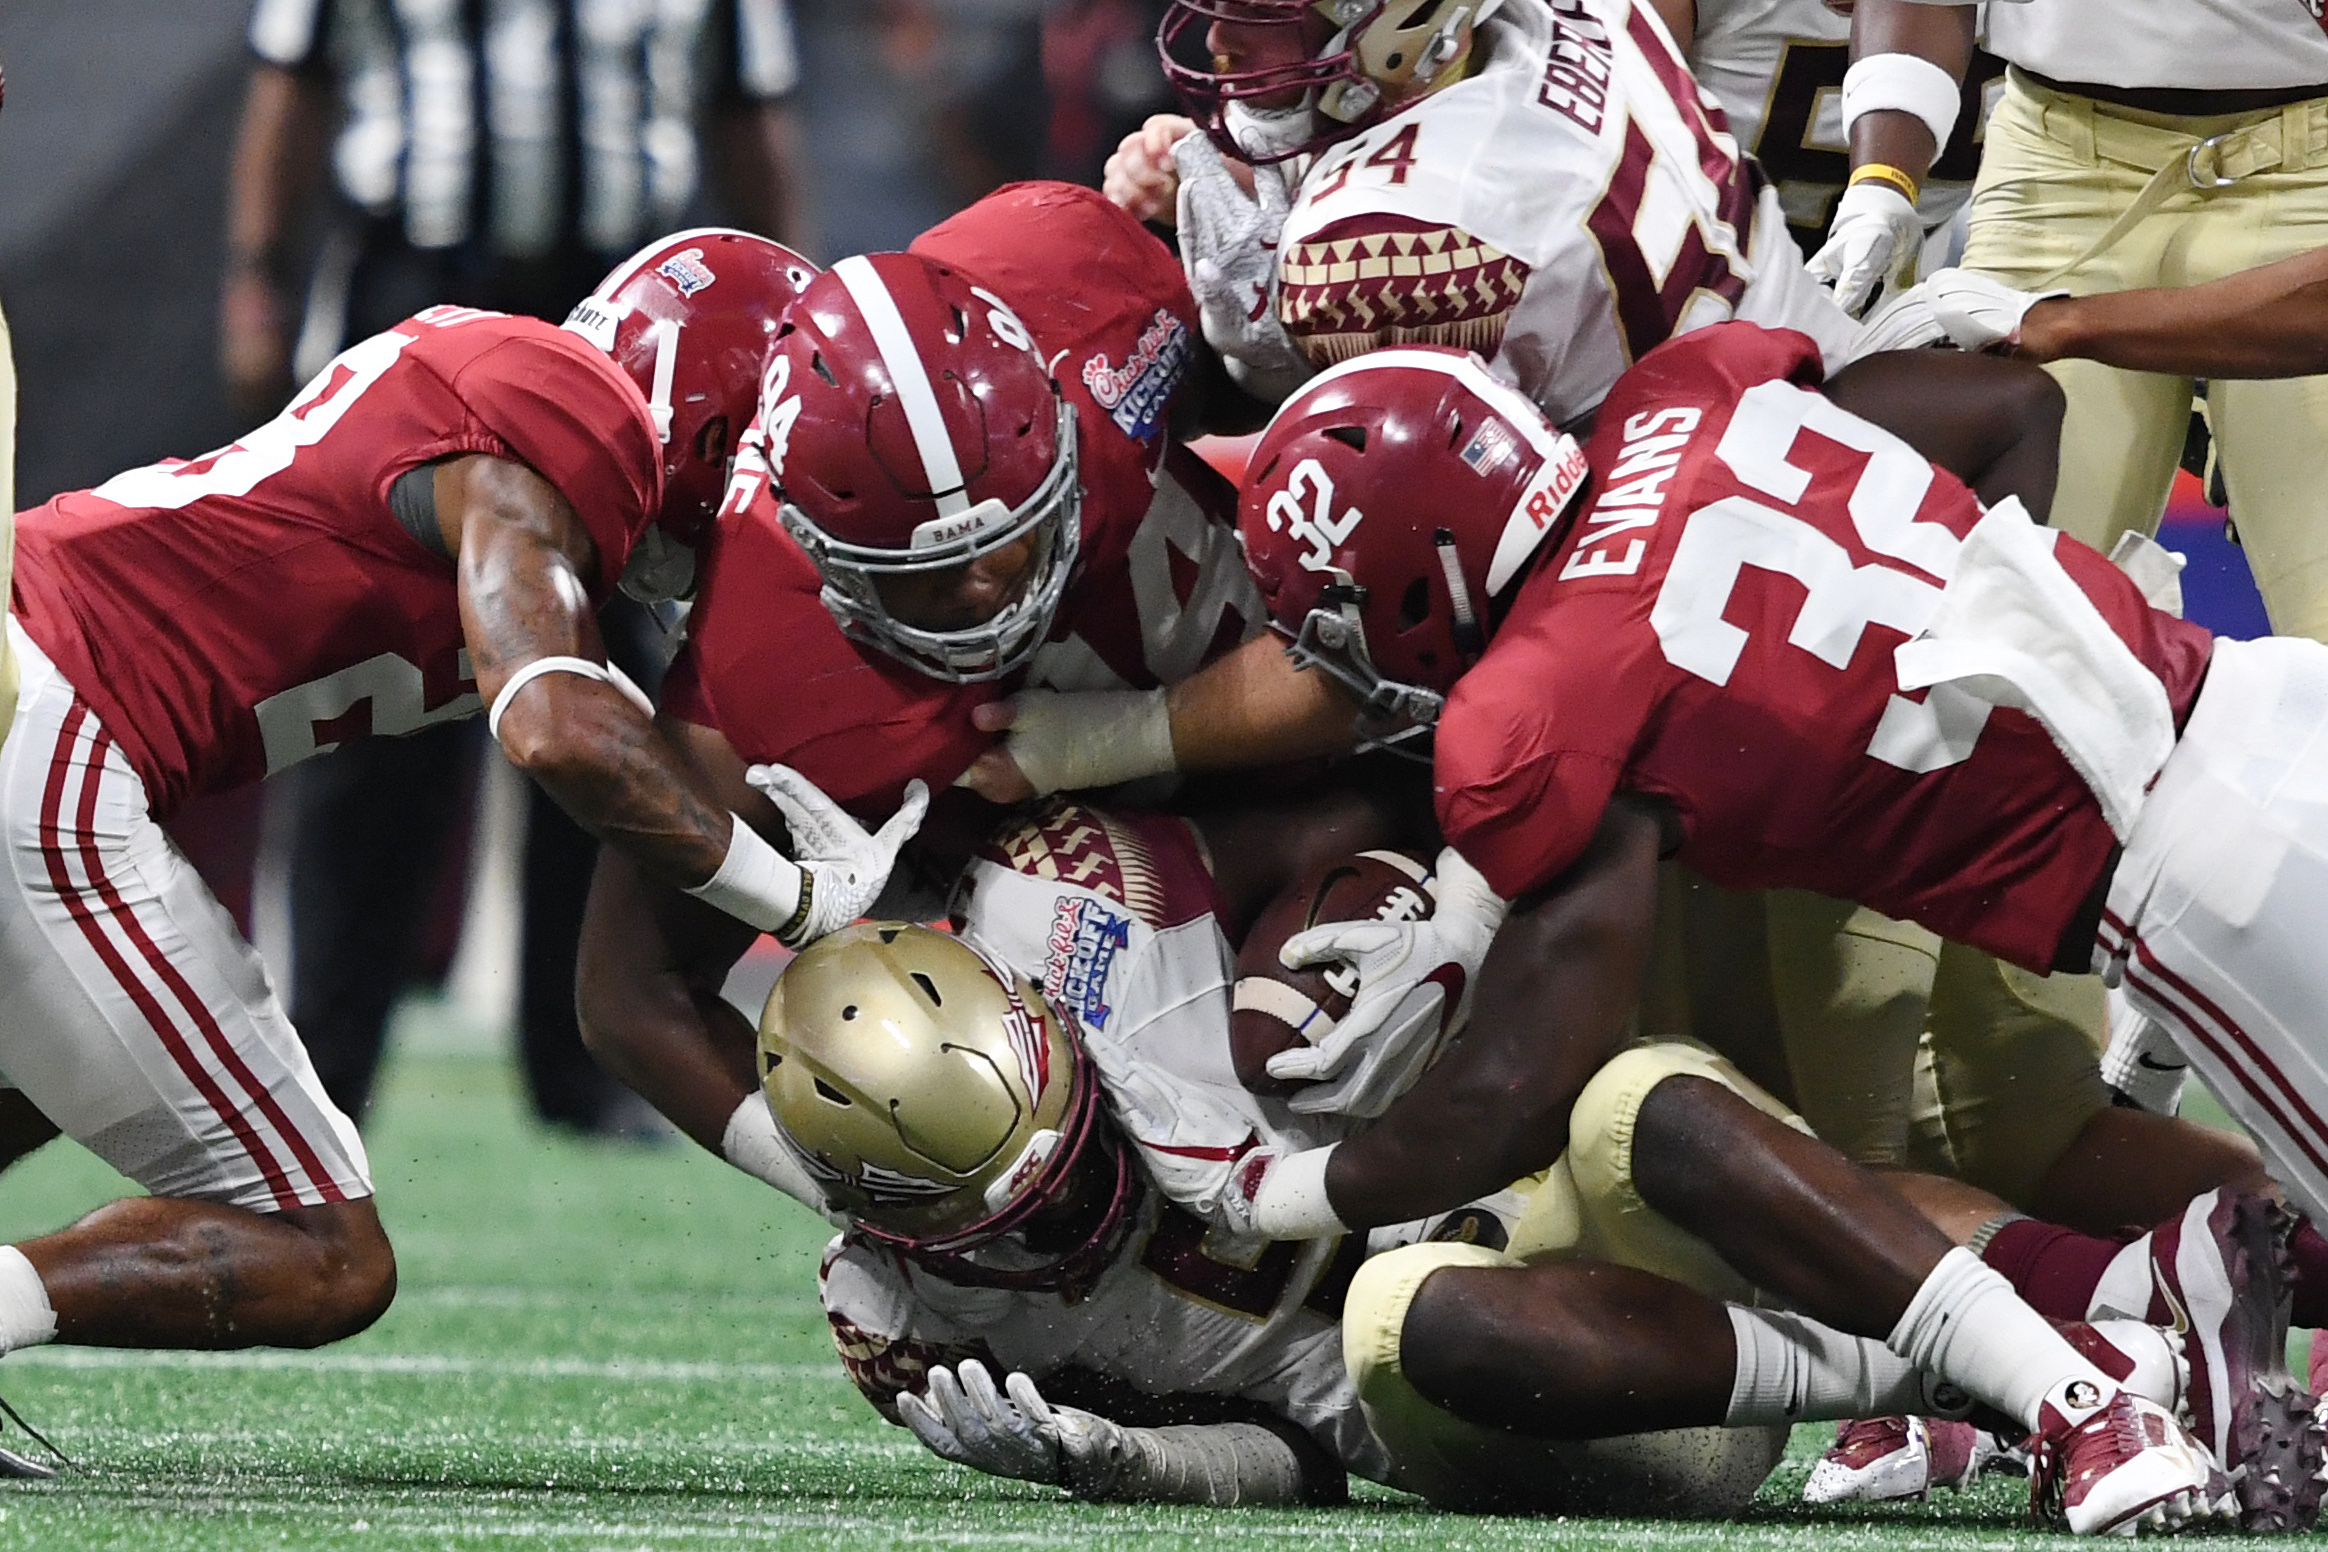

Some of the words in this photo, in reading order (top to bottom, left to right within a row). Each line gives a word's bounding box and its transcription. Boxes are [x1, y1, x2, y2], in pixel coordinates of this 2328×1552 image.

[933, 517, 985, 543] BAMA
[1266, 457, 1362, 572] 32
[1558, 407, 1703, 581] EVANS
[1649, 378, 1994, 774] 32
[1044, 901, 1081, 998] hick-fil-A
[1087, 933, 1116, 1011] GAME
[1008, 1149, 1042, 1193] ACC
